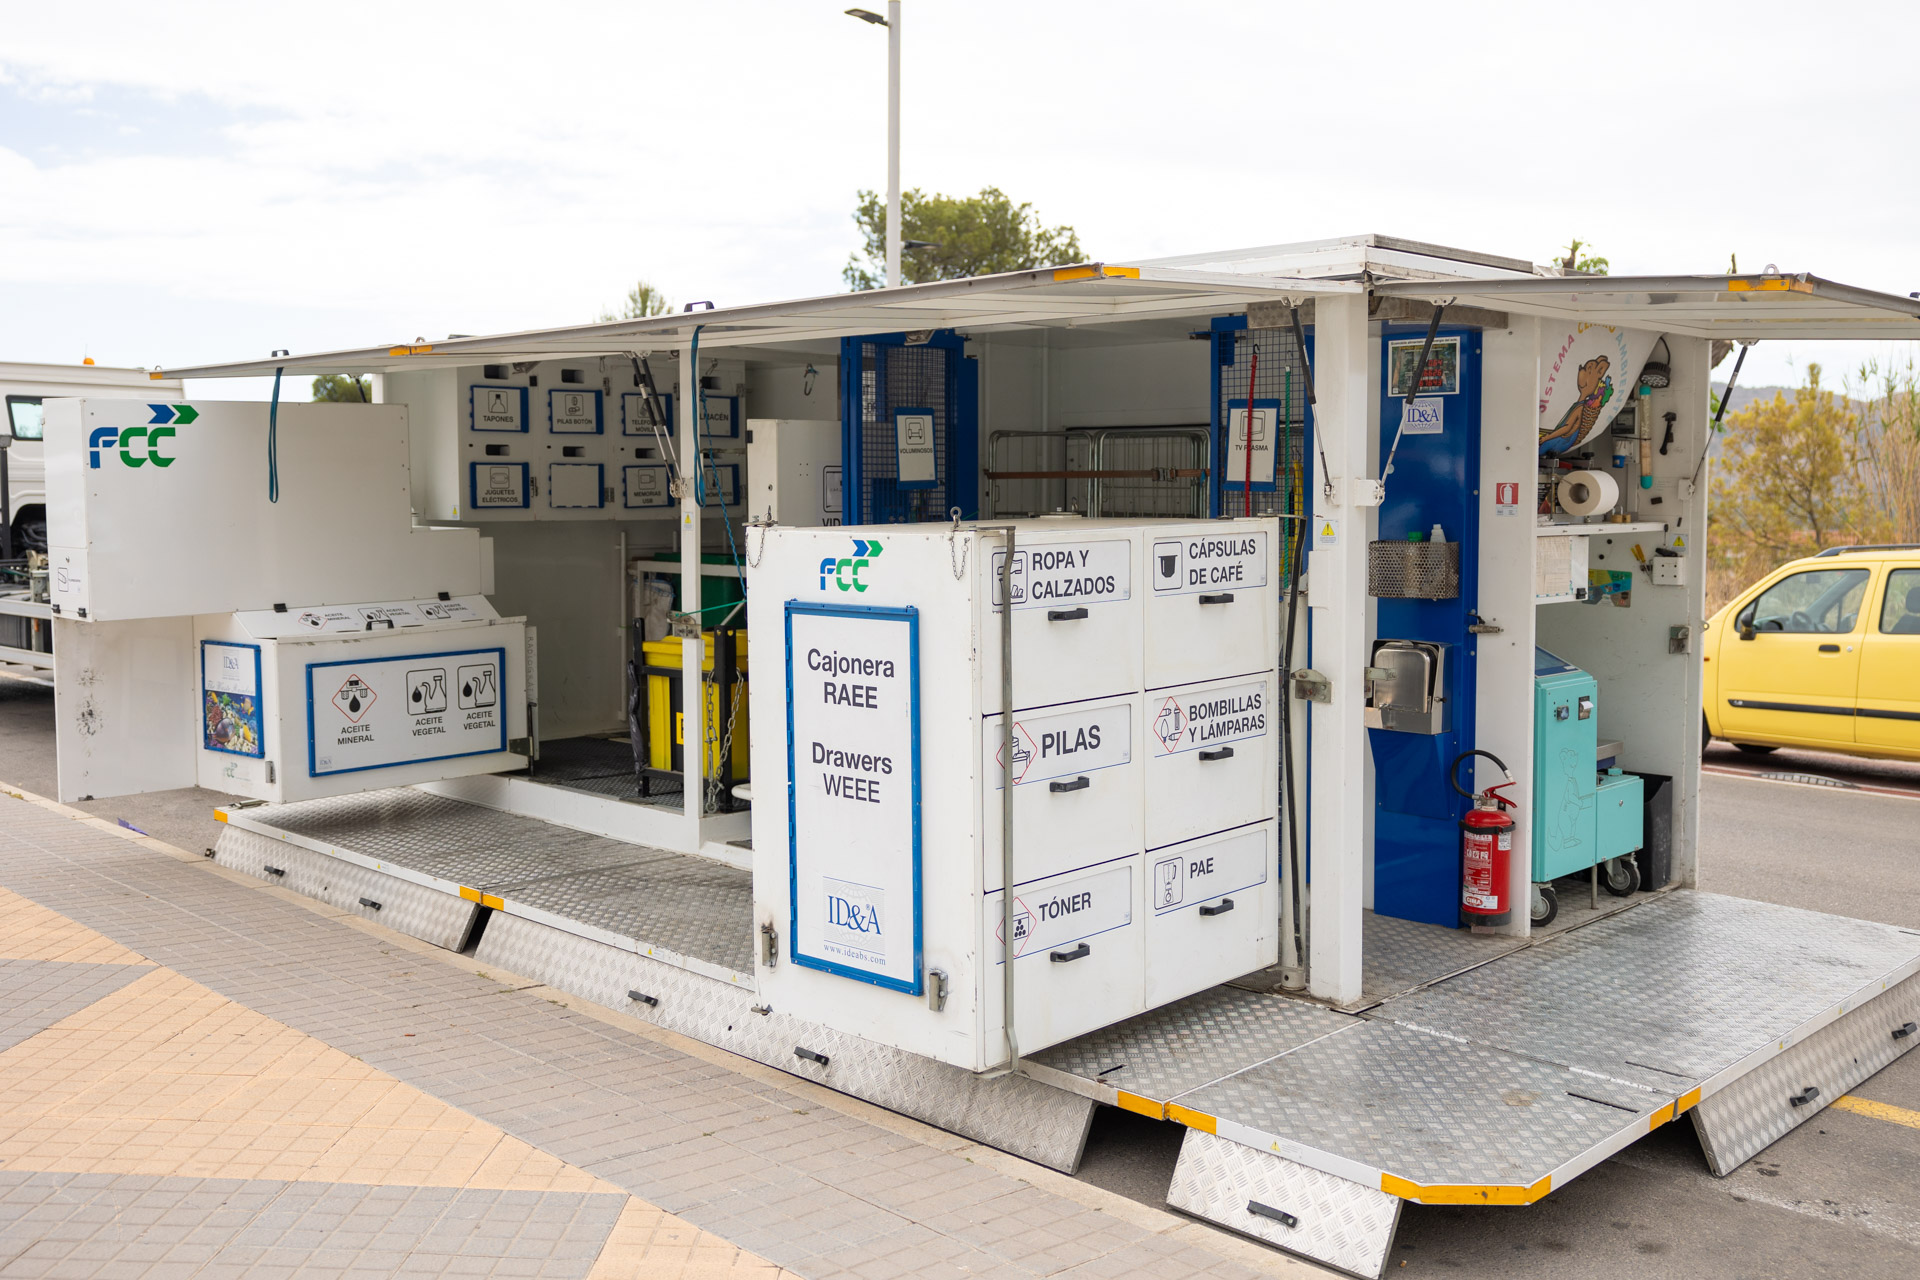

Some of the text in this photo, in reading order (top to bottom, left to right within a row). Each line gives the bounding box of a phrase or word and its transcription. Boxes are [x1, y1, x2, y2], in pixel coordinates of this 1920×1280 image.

[483, 415, 514, 423] TAPONES
[699, 413, 729, 421] LMACÉN
[1407, 408, 1440, 423] ID&A
[89, 427, 176, 469] FCC
[482, 496, 518, 504] ELÉCTRICOS
[1189, 538, 1256, 559] CÁPSULAS
[1032, 549, 1090, 571] ROPA Y
[820, 557, 869, 593] FCC
[1189, 560, 1243, 586] DE CAFÉ
[1032, 575, 1116, 600] CALZADOS
[807, 648, 895, 678] Cajonera
[823, 681, 879, 709] RAEE
[466, 711, 493, 720] ACEITE
[1189, 693, 1262, 722] BOMBILLAS
[340, 724, 371, 735] ACEITE
[412, 726, 446, 736] VEGETAL
[415, 716, 443, 726] ACEITE
[463, 720, 496, 731] VEGETAL
[1189, 713, 1265, 743] Y LÁMPARAS
[337, 734, 375, 745] MINERAL
[1042, 724, 1101, 759] PILAS
[812, 741, 893, 774] Drawers
[823, 773, 881, 804] WEEE
[1190, 857, 1214, 879] PAE
[827, 895, 882, 935] ID&A
[1038, 891, 1091, 922] TÓNER
[823, 944, 886, 966] www.ideabs.com
